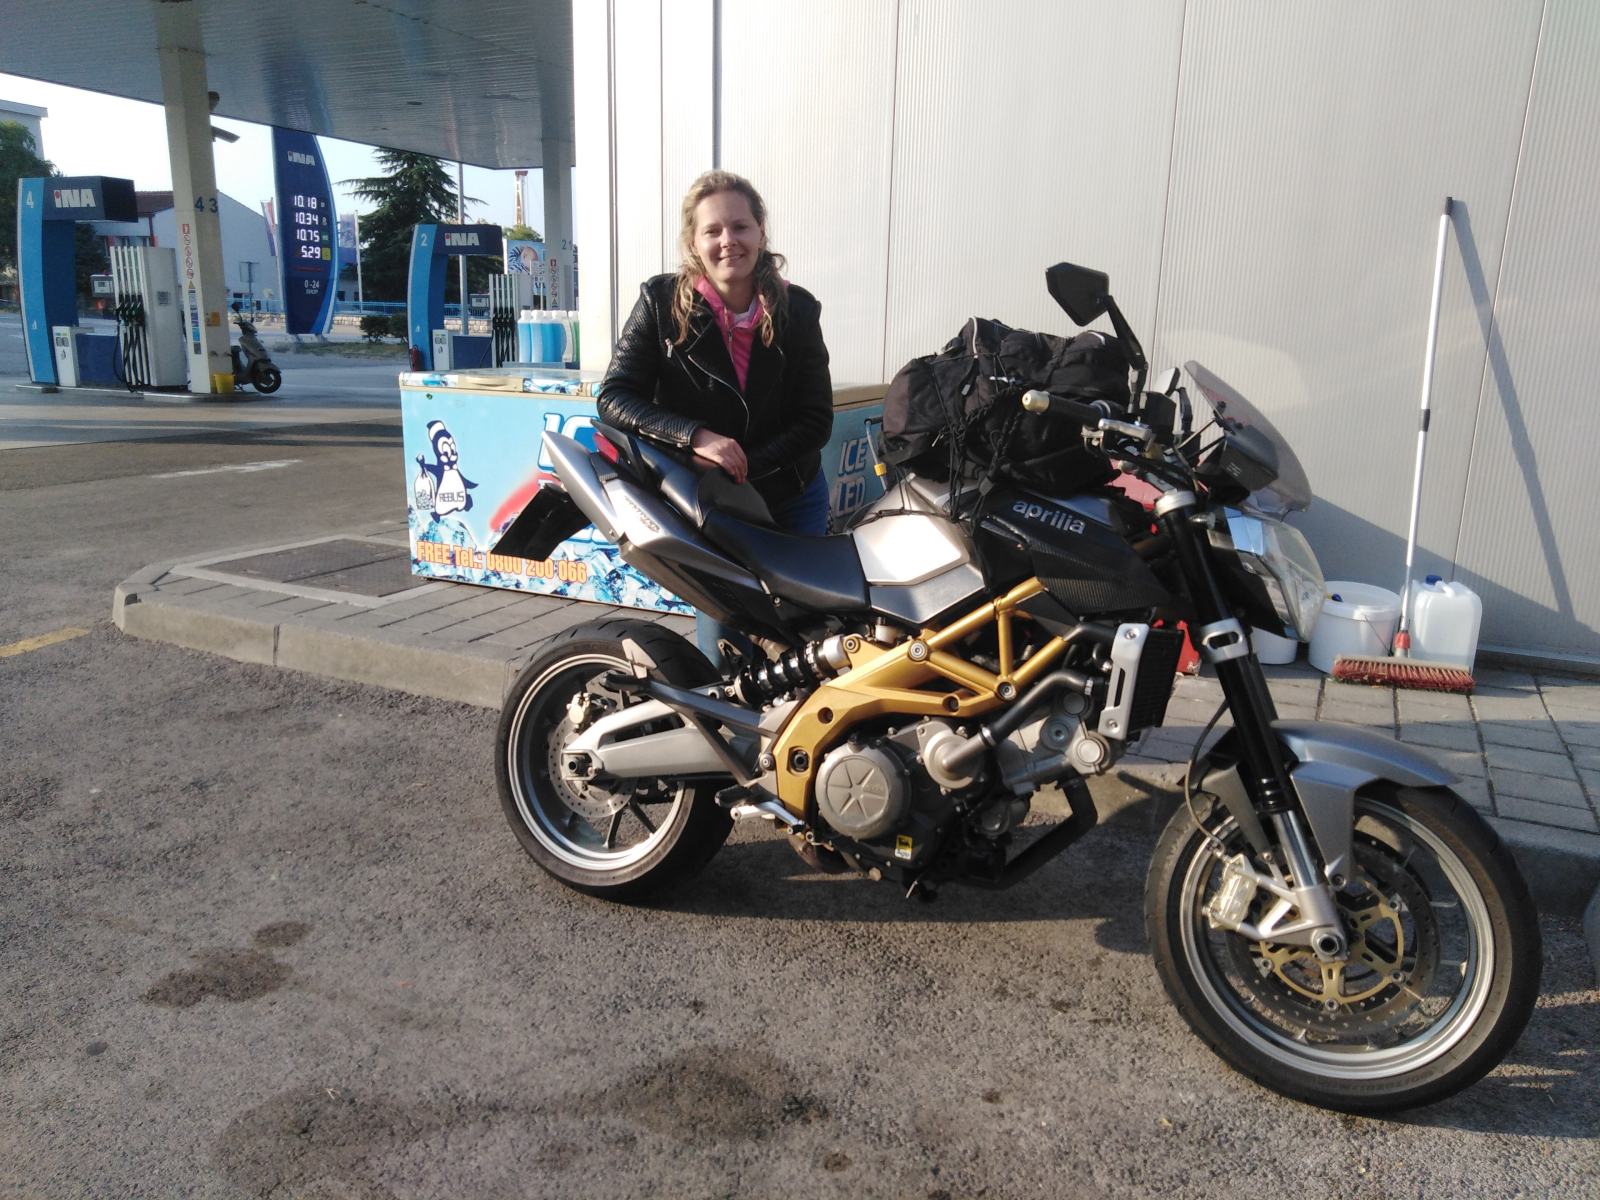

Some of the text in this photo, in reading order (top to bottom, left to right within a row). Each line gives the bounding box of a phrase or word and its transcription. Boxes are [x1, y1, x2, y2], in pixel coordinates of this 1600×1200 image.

[25, 191, 34, 209] 4
[194, 196, 219, 214] 4 3
[420, 233, 428, 247] 2
[838, 437, 870, 476] ICE
[438, 491, 465, 503] REBUS
[1012, 500, 1086, 535] aprilia
[416, 540, 588, 584] FREE Tel.: 0800 200 066
